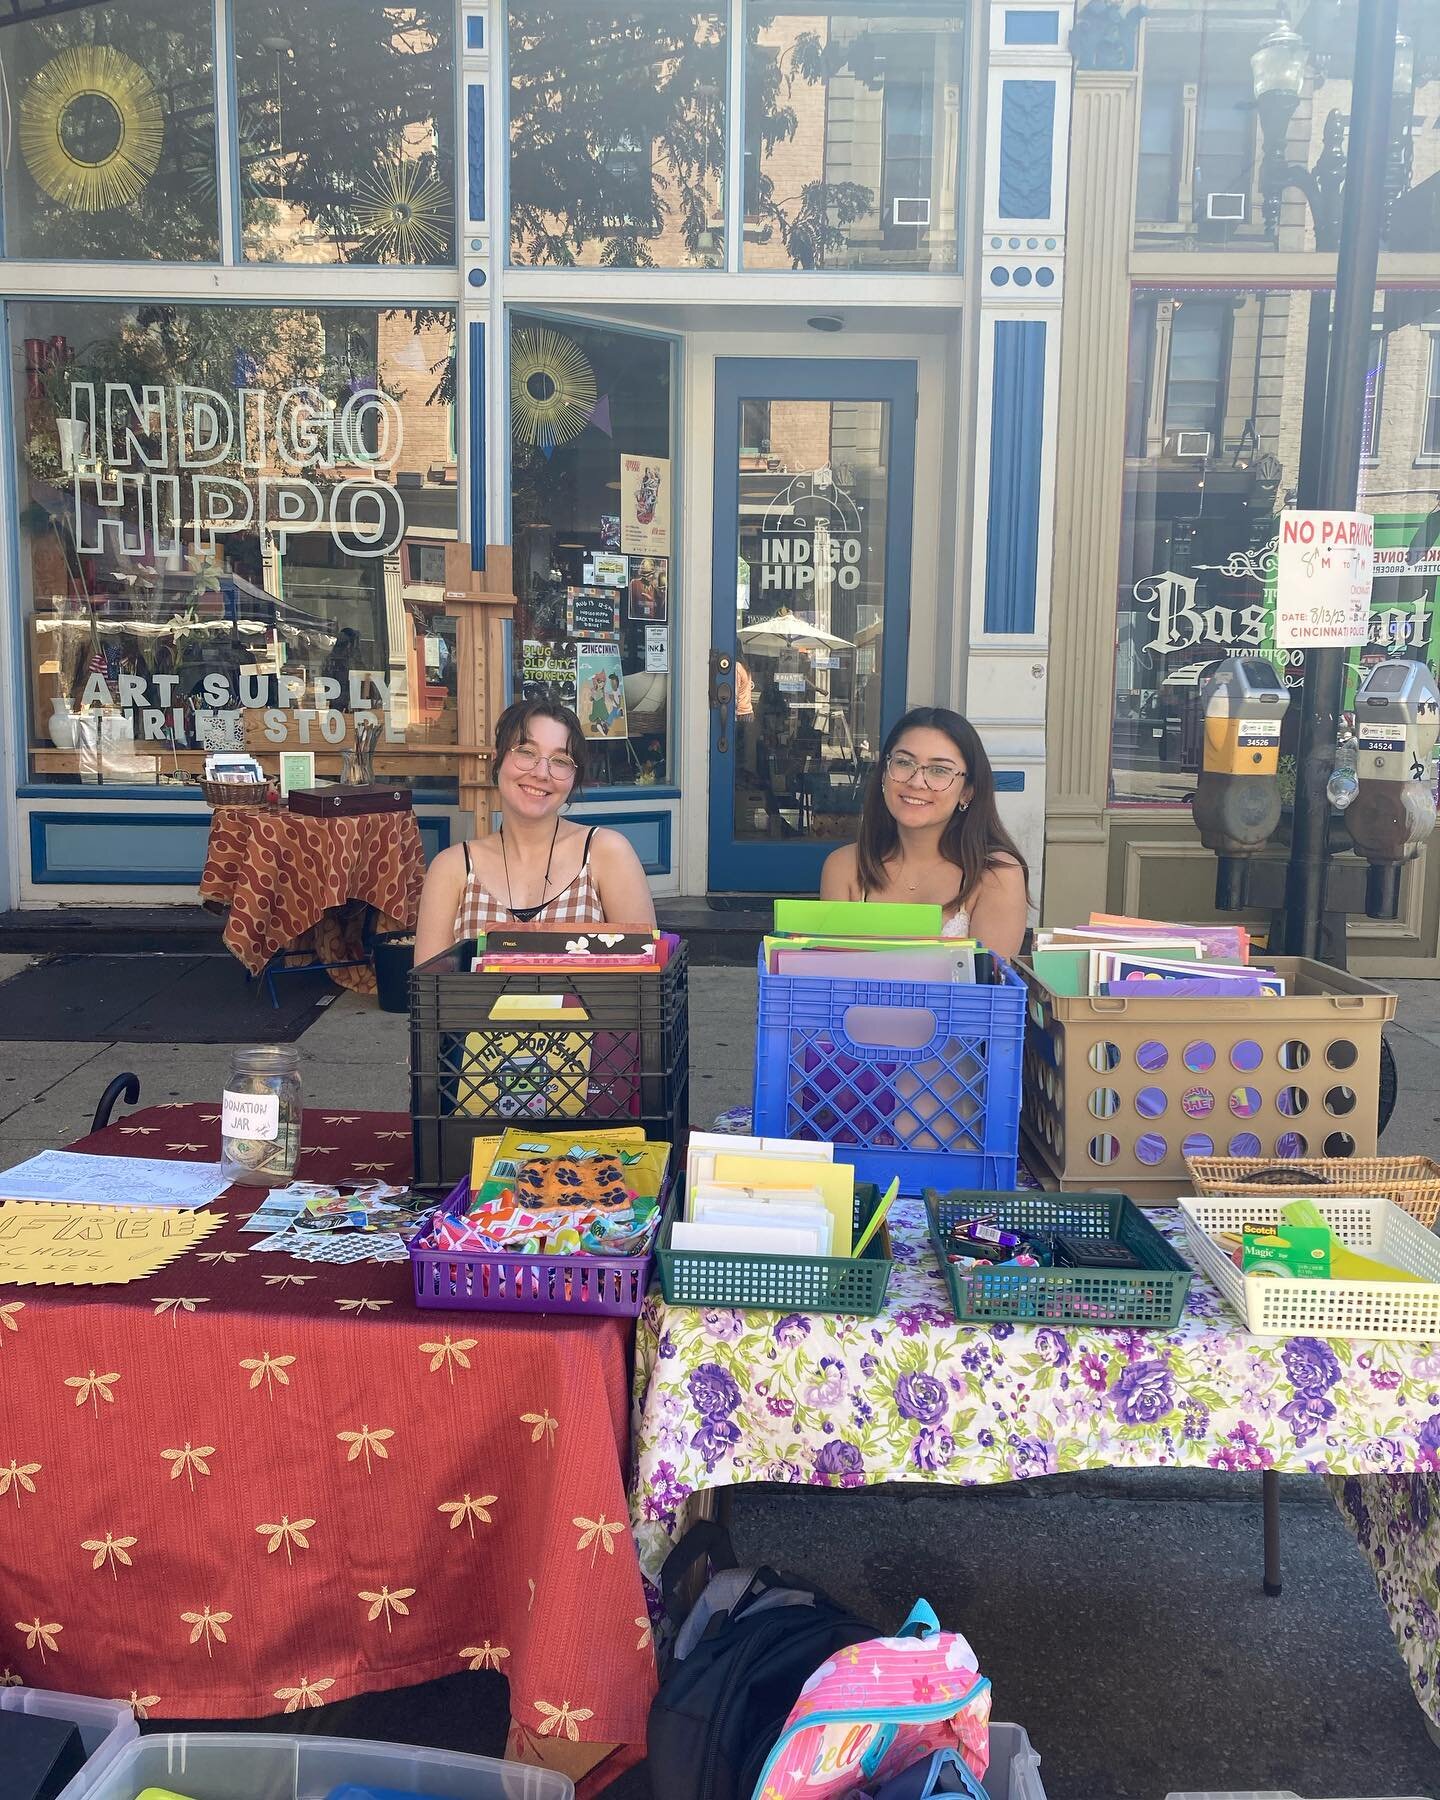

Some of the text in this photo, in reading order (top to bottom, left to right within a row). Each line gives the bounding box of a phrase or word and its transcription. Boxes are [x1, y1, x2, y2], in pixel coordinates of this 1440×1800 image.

[70, 382, 404, 470] INDIGO
[73, 472, 405, 557] HIPPO
[1283, 520, 1373, 546] NO PARKING
[761, 538, 861, 564] INDIGO
[761, 565, 860, 590] HIPPO
[1281, 612, 1308, 622] DATE:
[1290, 626, 1365, 637] CINCINNATI POLICE
[523, 644, 552, 656] PLUG
[523, 658, 571, 670] OLD CITY
[523, 670, 576, 682] STOKELYS
[81, 672, 393, 709] ART SUPPLY
[263, 709, 406, 744] STORE
[1246, 739, 1269, 747] 34526
[1368, 742, 1393, 751] 34524
[223, 1098, 268, 1115] DONATION
[230, 1116, 250, 1131] JAR
[0, 1214, 197, 1241] FREE
[1244, 1224, 1277, 1235] Scotch
[0, 1243, 108, 1258] CHOOL
[1245, 1245, 1275, 1258] Magic
